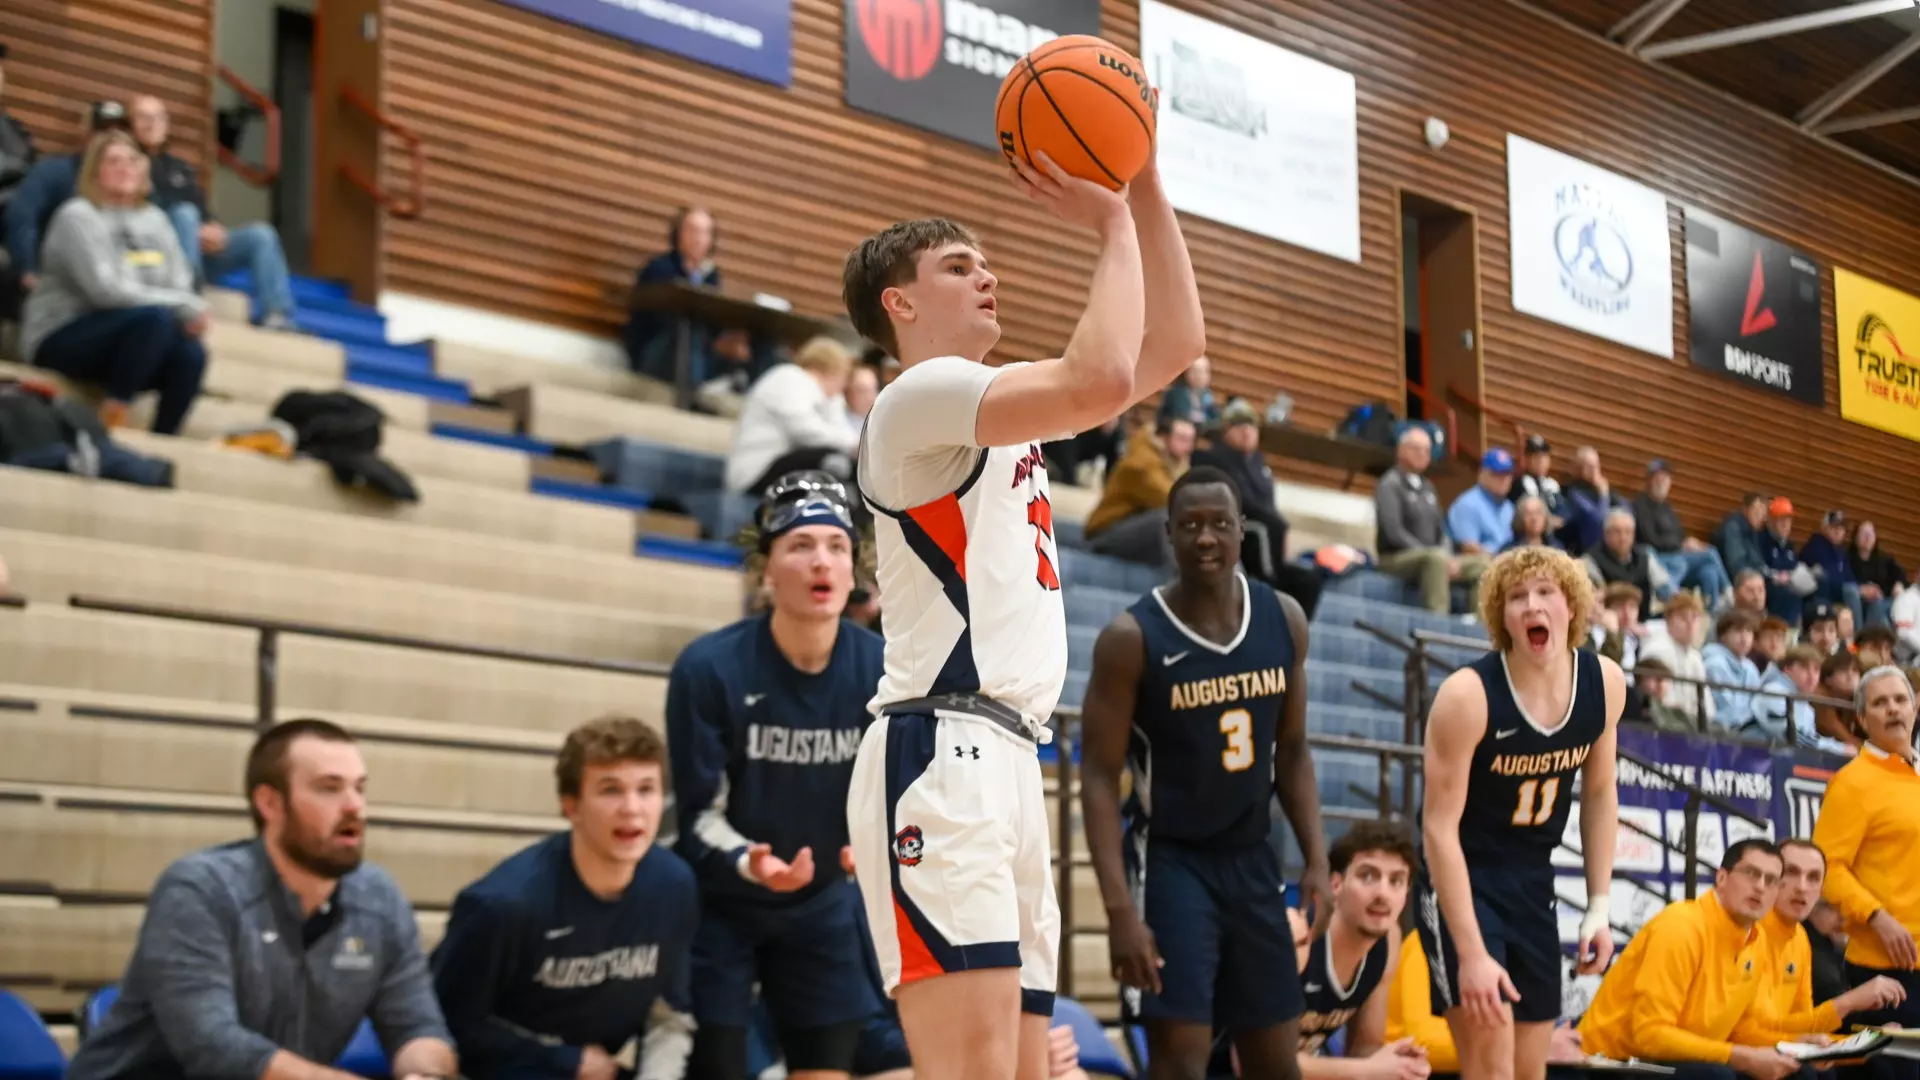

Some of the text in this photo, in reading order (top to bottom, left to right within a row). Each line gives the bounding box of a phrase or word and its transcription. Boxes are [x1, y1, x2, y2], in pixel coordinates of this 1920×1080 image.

[1854, 344, 1920, 391] TRUST
[1170, 666, 1286, 711] AUGUSTANA
[746, 723, 862, 765] UGUSTANA
[1220, 707, 1255, 772] 3
[1511, 777, 1560, 827] 11
